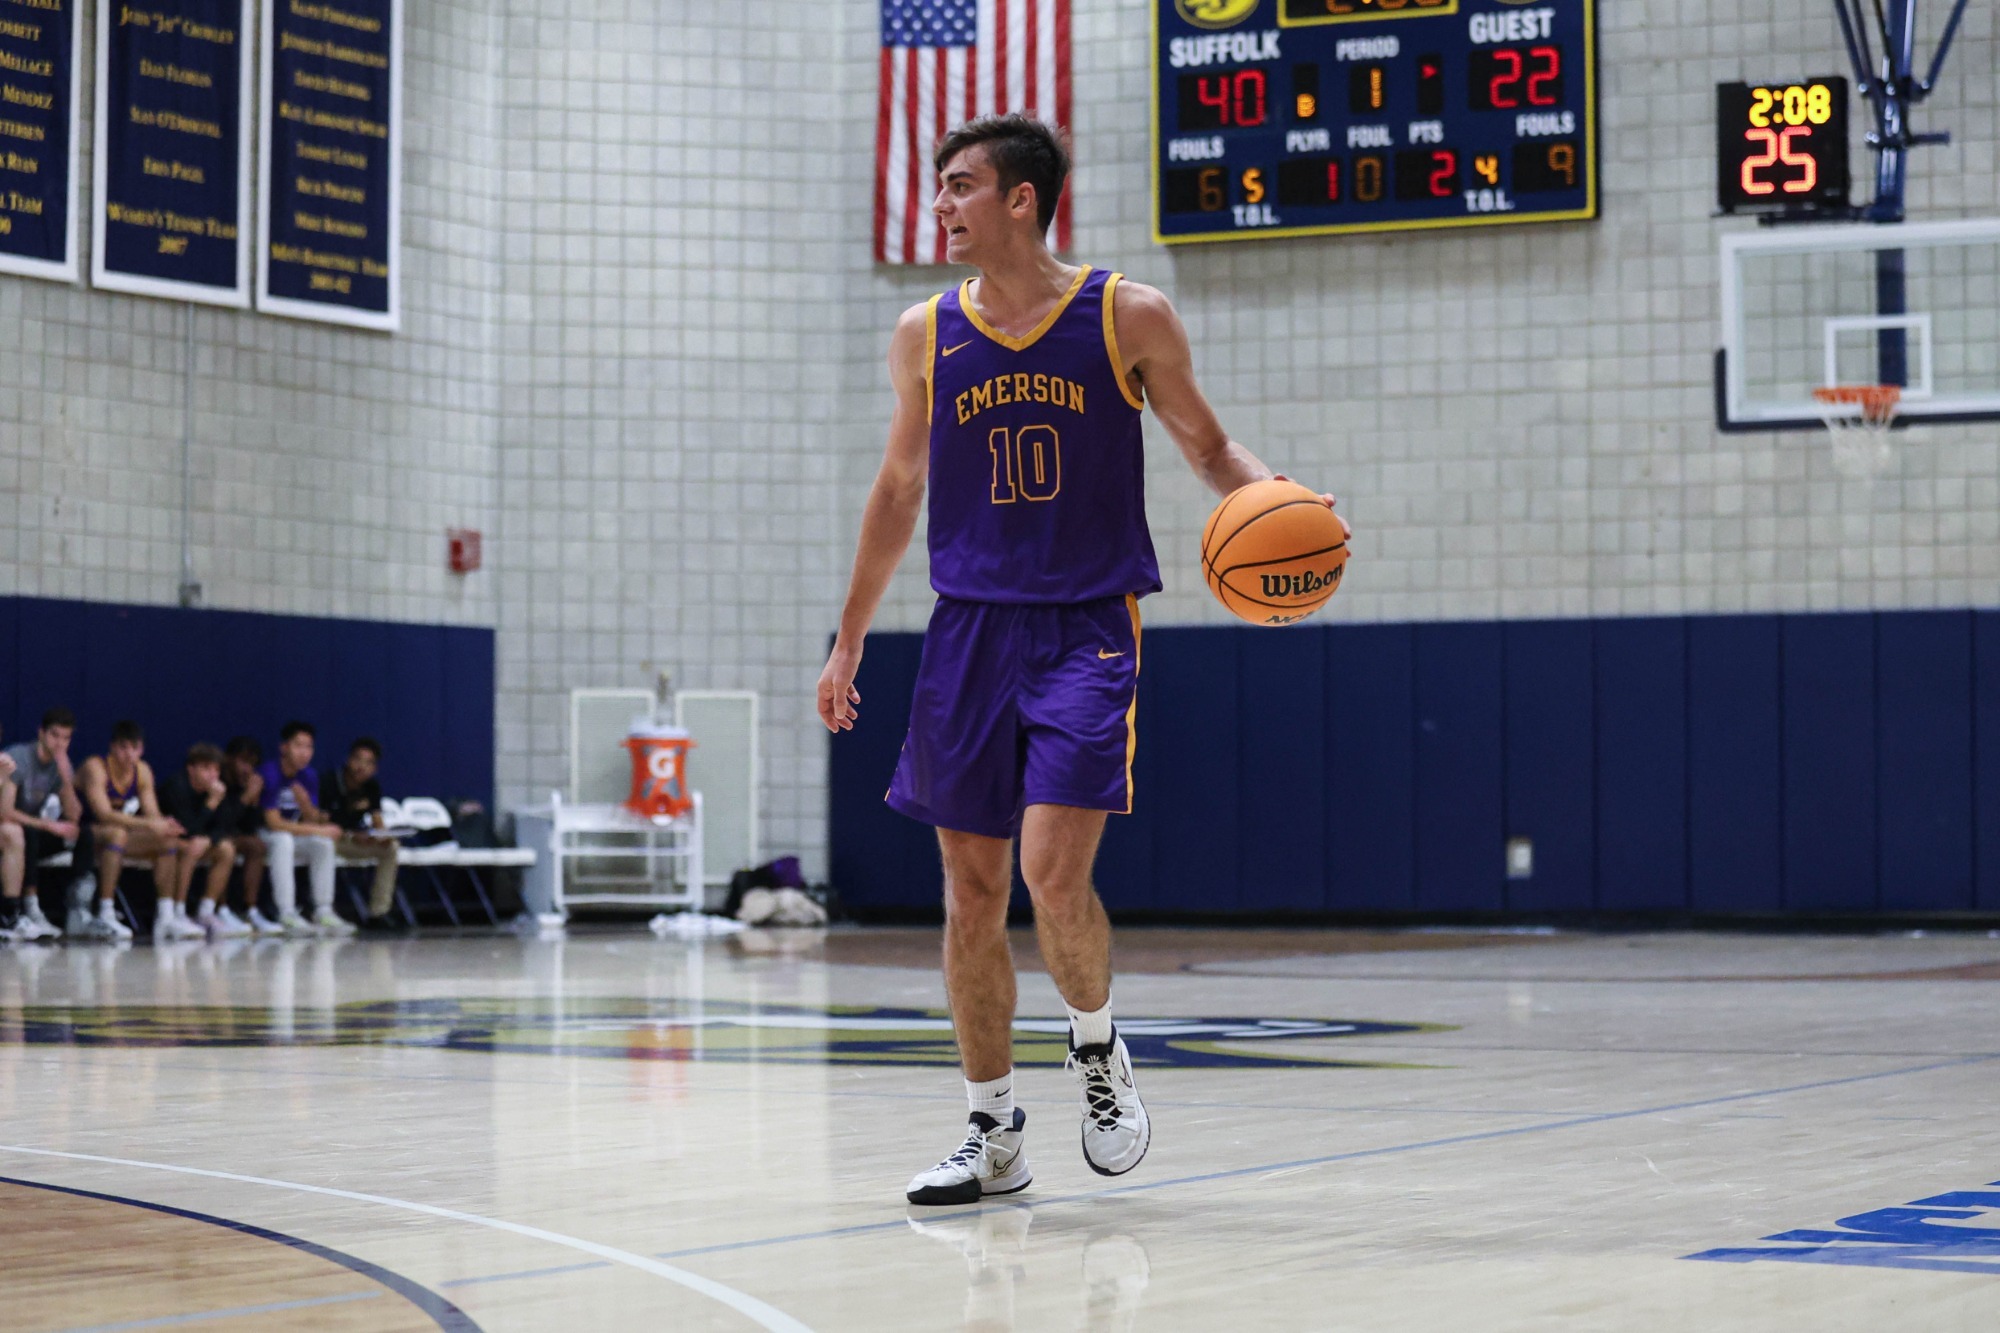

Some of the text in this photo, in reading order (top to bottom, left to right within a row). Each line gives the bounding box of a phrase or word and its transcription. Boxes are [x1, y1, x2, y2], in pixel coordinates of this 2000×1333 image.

[1469, 9, 1555, 44] GUEST
[1169, 29, 1281, 68] SUFFOLK
[1336, 36, 1399, 61] PERIOD
[1198, 69, 1266, 126] 40
[1370, 68, 1382, 108] 1
[1489, 47, 1562, 108] 22
[1516, 110, 1575, 137] FOULS
[1749, 84, 1831, 127] 2:08
[1168, 136, 1225, 161] FOULS
[1286, 128, 1331, 153] PLYR
[1347, 125, 1393, 147] FOUL
[1408, 120, 1444, 144] PTS
[1356, 157, 1381, 201] 0
[1429, 151, 1456, 197] 2
[1547, 144, 1575, 185] 9
[1741, 126, 1817, 195] 25
[1200, 167, 1222, 211] 6
[1327, 162, 1338, 200] 1
[955, 372, 1085, 425] EMERSON
[989, 424, 1061, 504] 10
[1260, 563, 1342, 597] Wilson
